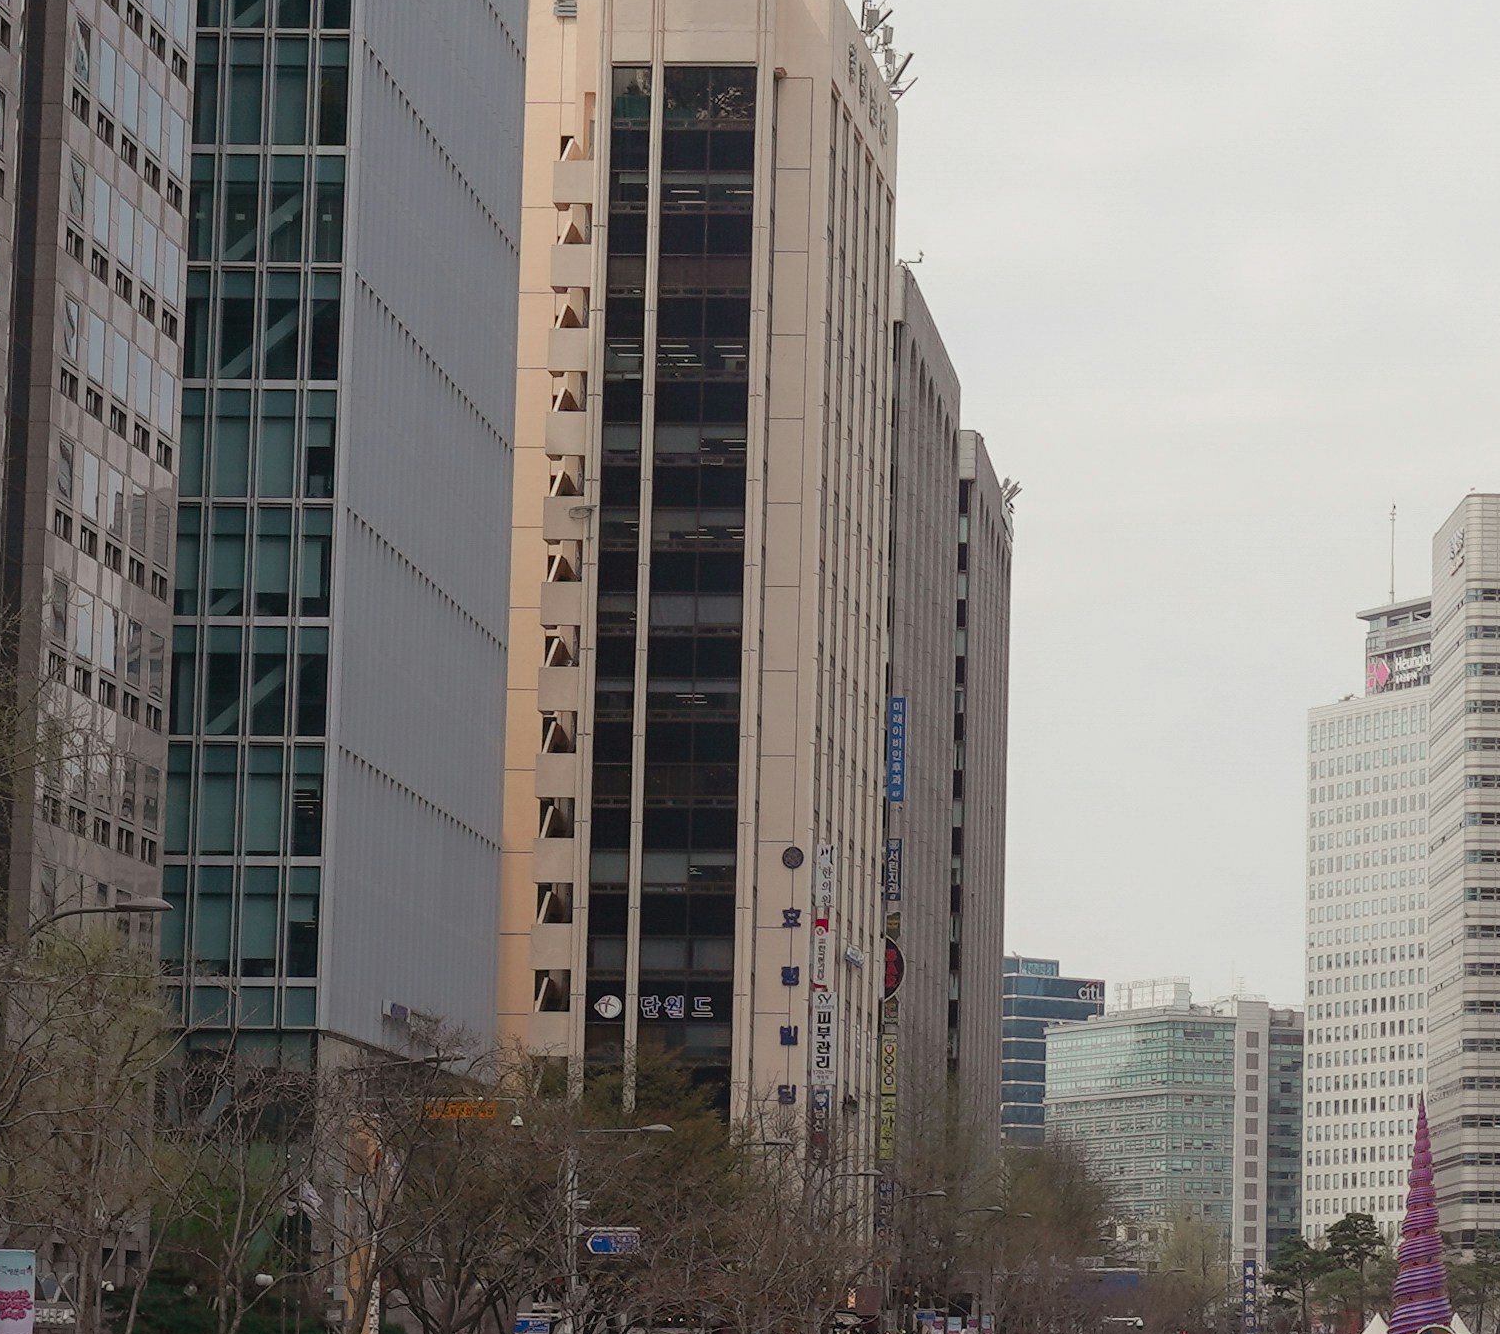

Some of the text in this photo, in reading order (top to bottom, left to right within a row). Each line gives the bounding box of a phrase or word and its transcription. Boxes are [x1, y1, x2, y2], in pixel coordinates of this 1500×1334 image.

[821, 866, 833, 906] 한의원
[640, 995, 714, 1018] 단월드
[816, 1011, 831, 1069] 피부관리
